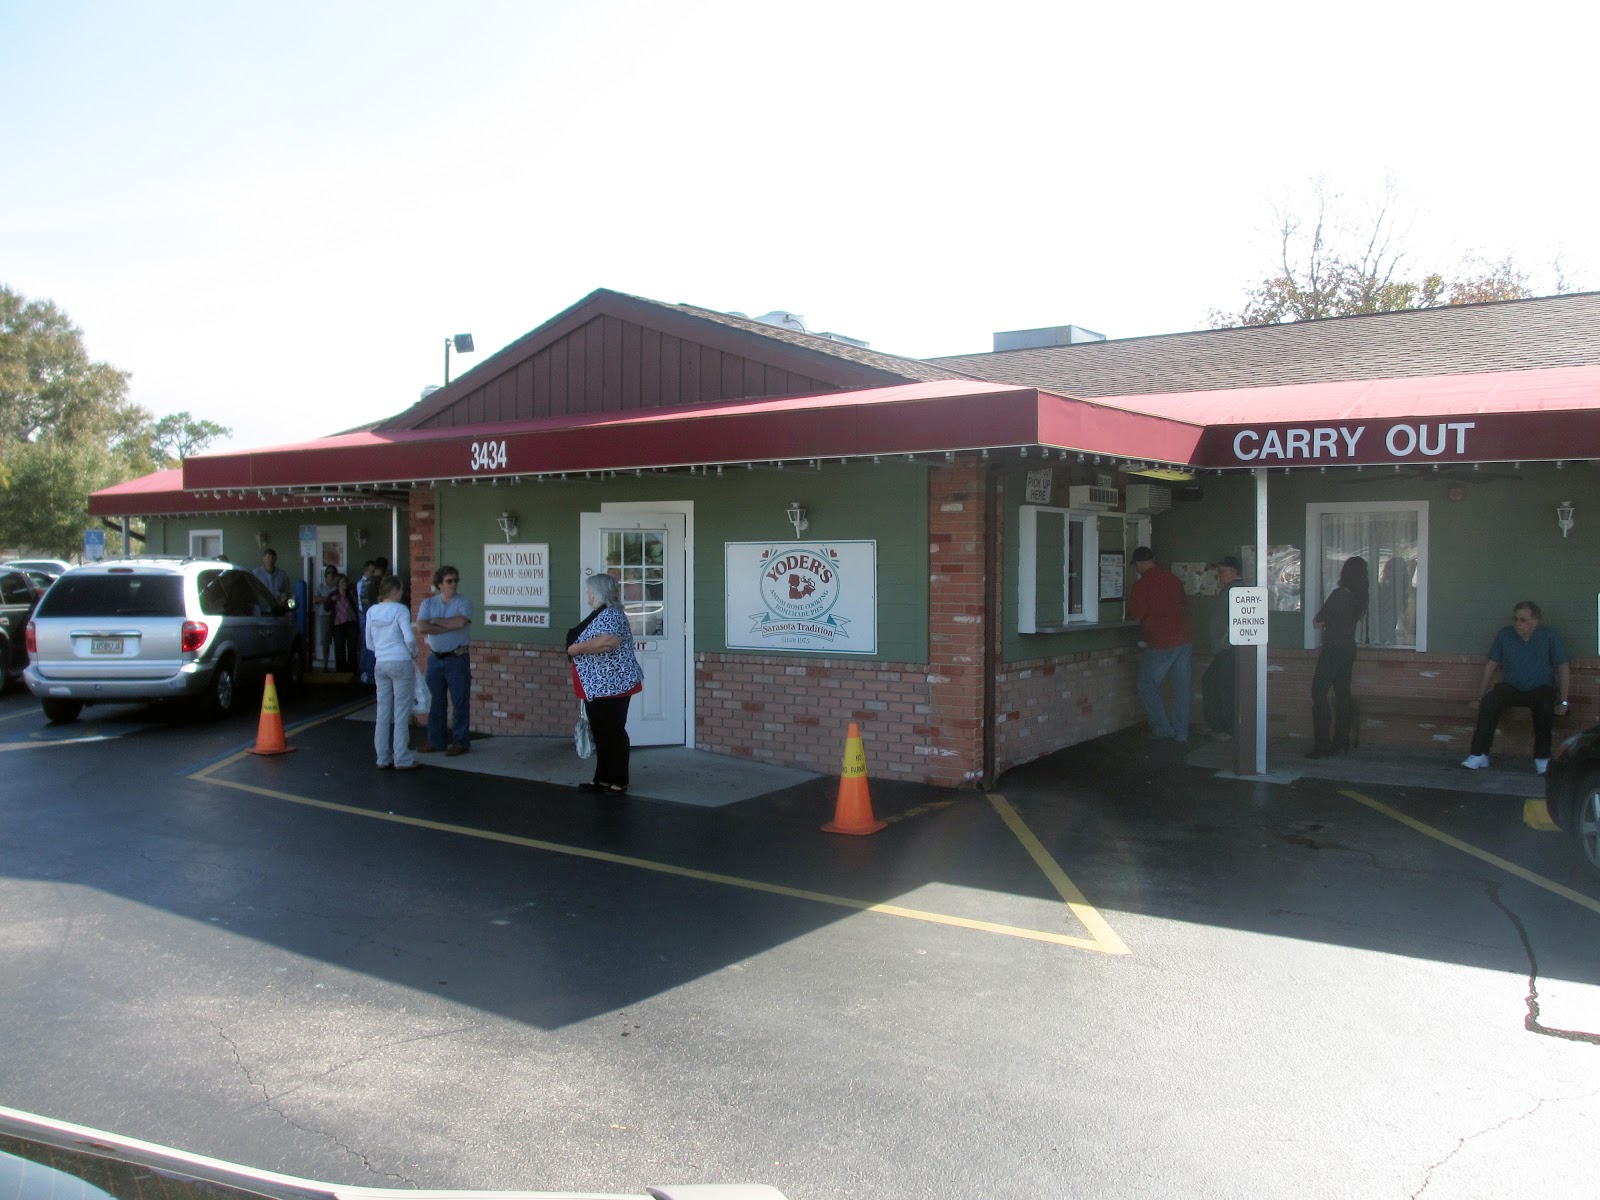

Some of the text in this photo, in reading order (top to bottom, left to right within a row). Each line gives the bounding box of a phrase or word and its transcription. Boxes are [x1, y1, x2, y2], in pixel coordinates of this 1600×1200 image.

[1233, 422, 1476, 461] CARRY OUT
[471, 440, 507, 470] 3434
[1042, 479, 1051, 489] UP
[1030, 489, 1046, 501] HERE
[488, 553, 543, 566] OPEN DAILY
[766, 554, 833, 584] YODER'S
[488, 585, 544, 596] CLOSED SUNDAY
[770, 589, 829, 611] AMISH HOME COOKING
[775, 603, 824, 617] HOMEMADE PIES
[1241, 607, 1256, 615] OUT
[500, 614, 545, 624] ENTRANCE
[1232, 617, 1265, 625] PARKING
[762, 623, 833, 638] Sarasota Tradition
[1239, 629, 1258, 637] ONLY
